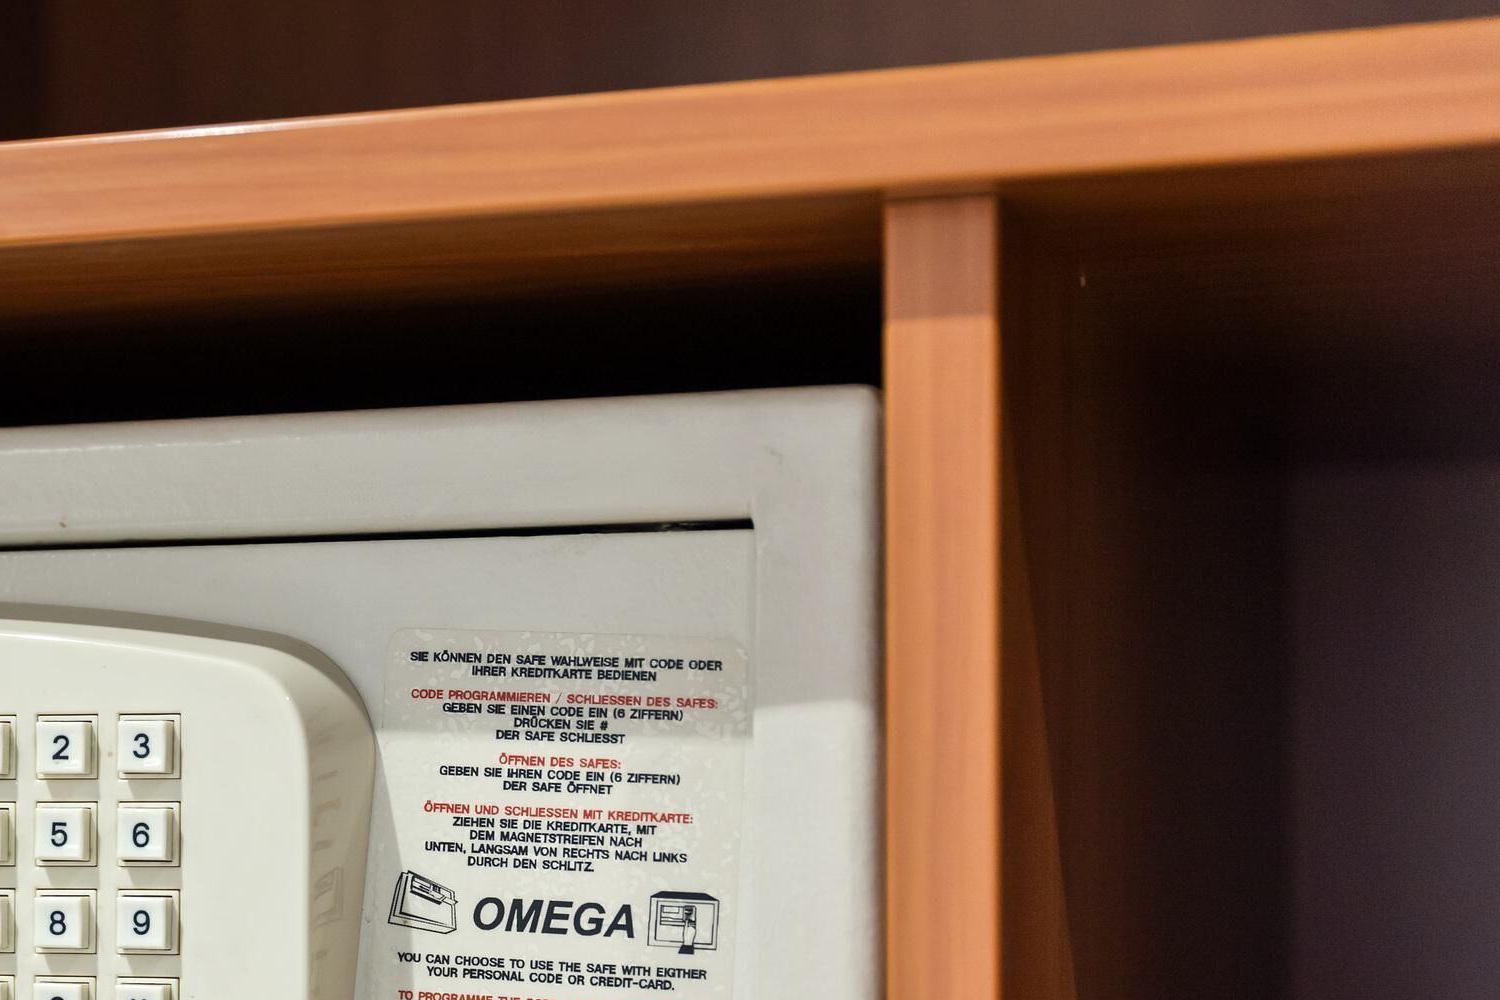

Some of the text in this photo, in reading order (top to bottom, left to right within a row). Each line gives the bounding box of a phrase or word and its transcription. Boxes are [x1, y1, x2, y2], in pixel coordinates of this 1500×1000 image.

[410, 650, 722, 670] SIE KÖNNEN DEN SAFE WAHLWEISE MIT CODE ODER
[472, 665, 656, 681] IHRER KREDITKARTE BEDIENEN
[411, 689, 443, 699] CODE
[448, 690, 550, 702] PROGRAMMIEREN
[567, 694, 641, 705] SCHLIESSEN
[646, 697, 670, 707] DES
[676, 697, 717, 708] SAFES:
[442, 702, 683, 721] GEBEN SIE EINEN CODE EIN (6 ZIFFERN)
[514, 715, 607, 730] DRÜCKEN SIE #
[496, 729, 625, 743] DER SAFE SCHLIESST
[52, 735, 70, 760] 2
[133, 733, 150, 759] 3
[499, 753, 620, 769] ÖFFNEN DES SAFES:
[439, 765, 680, 785] GEBEN SIE IHREN CODE EIN (6 ZIFFERN)
[503, 780, 613, 794] DER SAFE ÖFFNET
[424, 800, 692, 823] ÖFFNEN UND SCHLIESSEN MIT KREDITKARTE:
[51, 822, 68, 847] 5
[132, 823, 151, 848] 6
[452, 816, 657, 835] ZIEHEN SIE DIE KREDITKARTE, MIT
[470, 829, 642, 847] DEM MAGNETSTREIFEN NACH
[425, 841, 686, 862] UNTEN, LANGSAM VON RECHTS NACH LINKS
[467, 856, 594, 872] DURCH DEN SCHLITZ.
[49, 910, 67, 935] 8
[133, 910, 151, 935] 9
[473, 897, 634, 938] OMEGA
[398, 952, 706, 979] YOU CAN CHOOSE TO USE THE SAFE WITH EIGTHER
[427, 966, 674, 990] YOUR PERSONAL CODE OR CREDIT-CARD.
[398, 990, 413, 1000] TO
